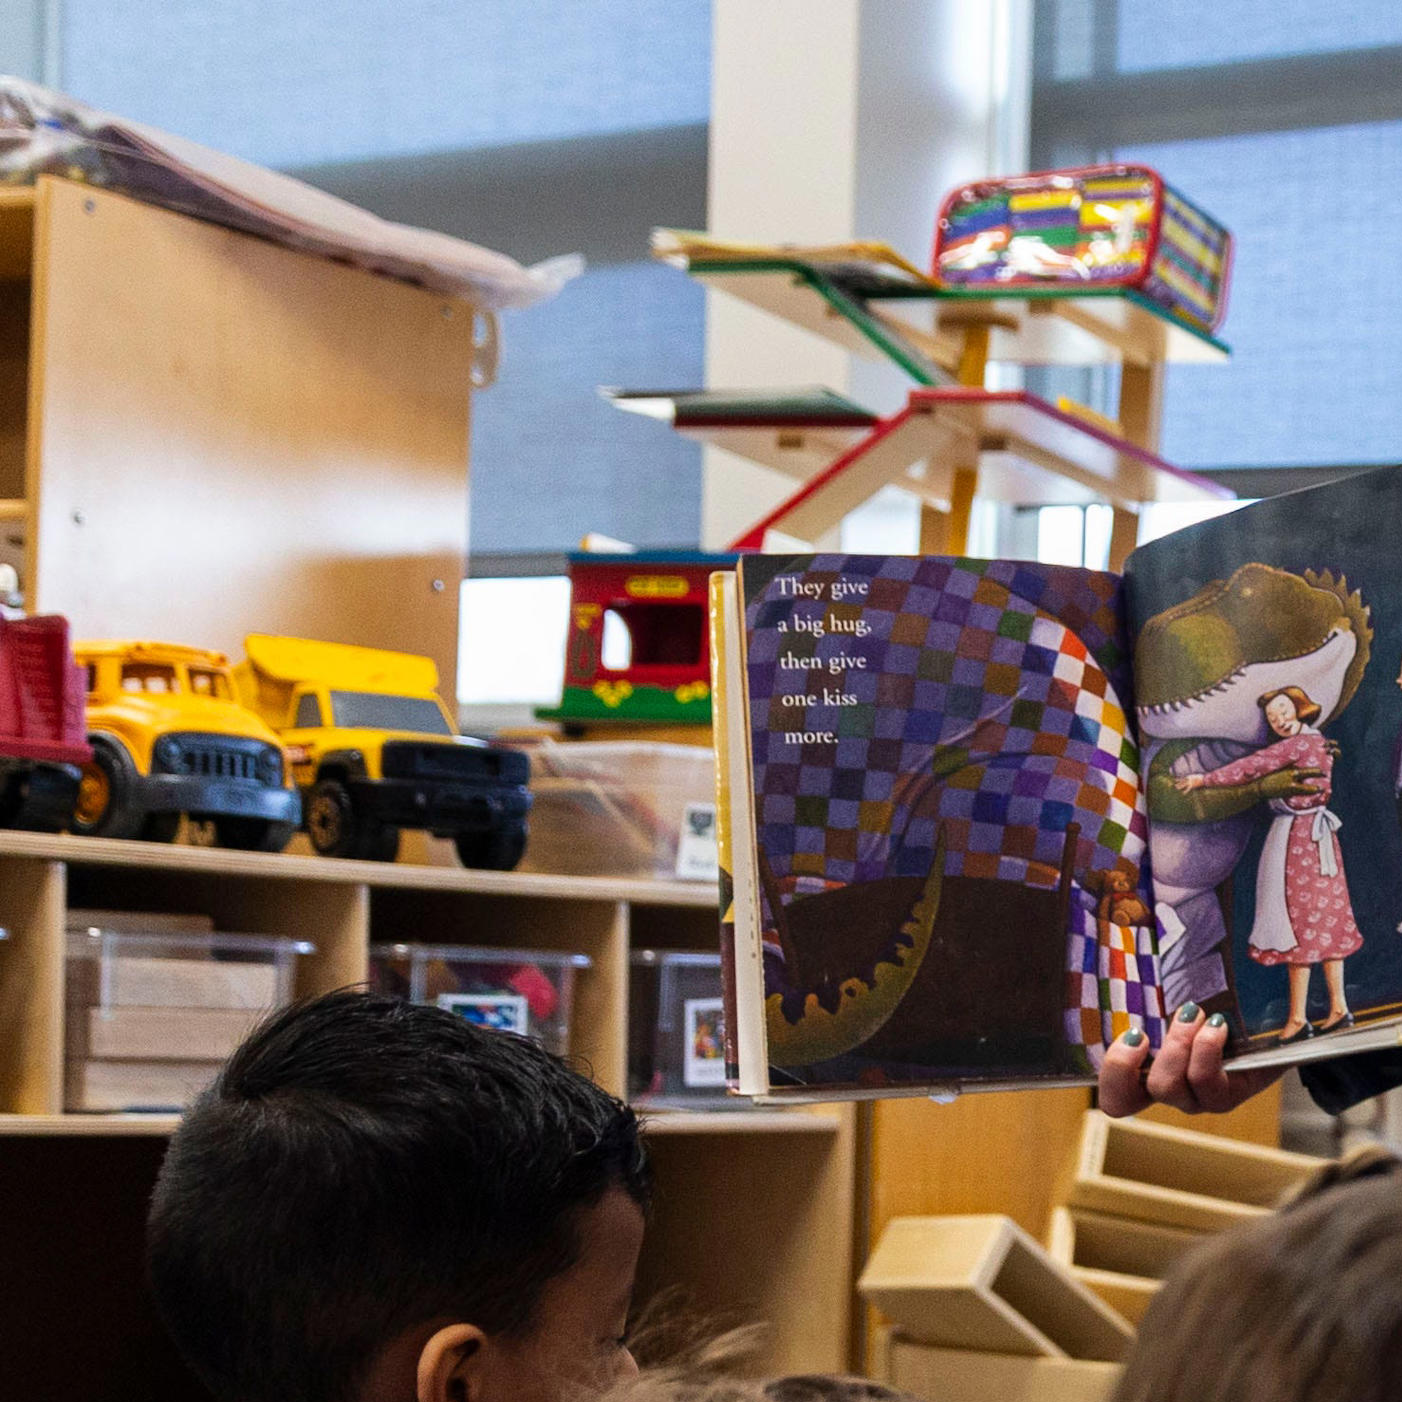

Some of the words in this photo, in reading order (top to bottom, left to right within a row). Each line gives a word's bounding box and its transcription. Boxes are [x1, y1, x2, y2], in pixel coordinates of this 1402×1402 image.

[774, 576, 825, 599] They
[831, 578, 869, 599] give
[777, 620, 788, 632] a
[794, 614, 825, 637] big
[830, 614, 872, 637] hug,
[780, 651, 822, 669] then
[829, 652, 867, 674] give
[782, 694, 817, 707] one
[823, 688, 858, 706] kiss
[784, 732, 839, 744] more.
